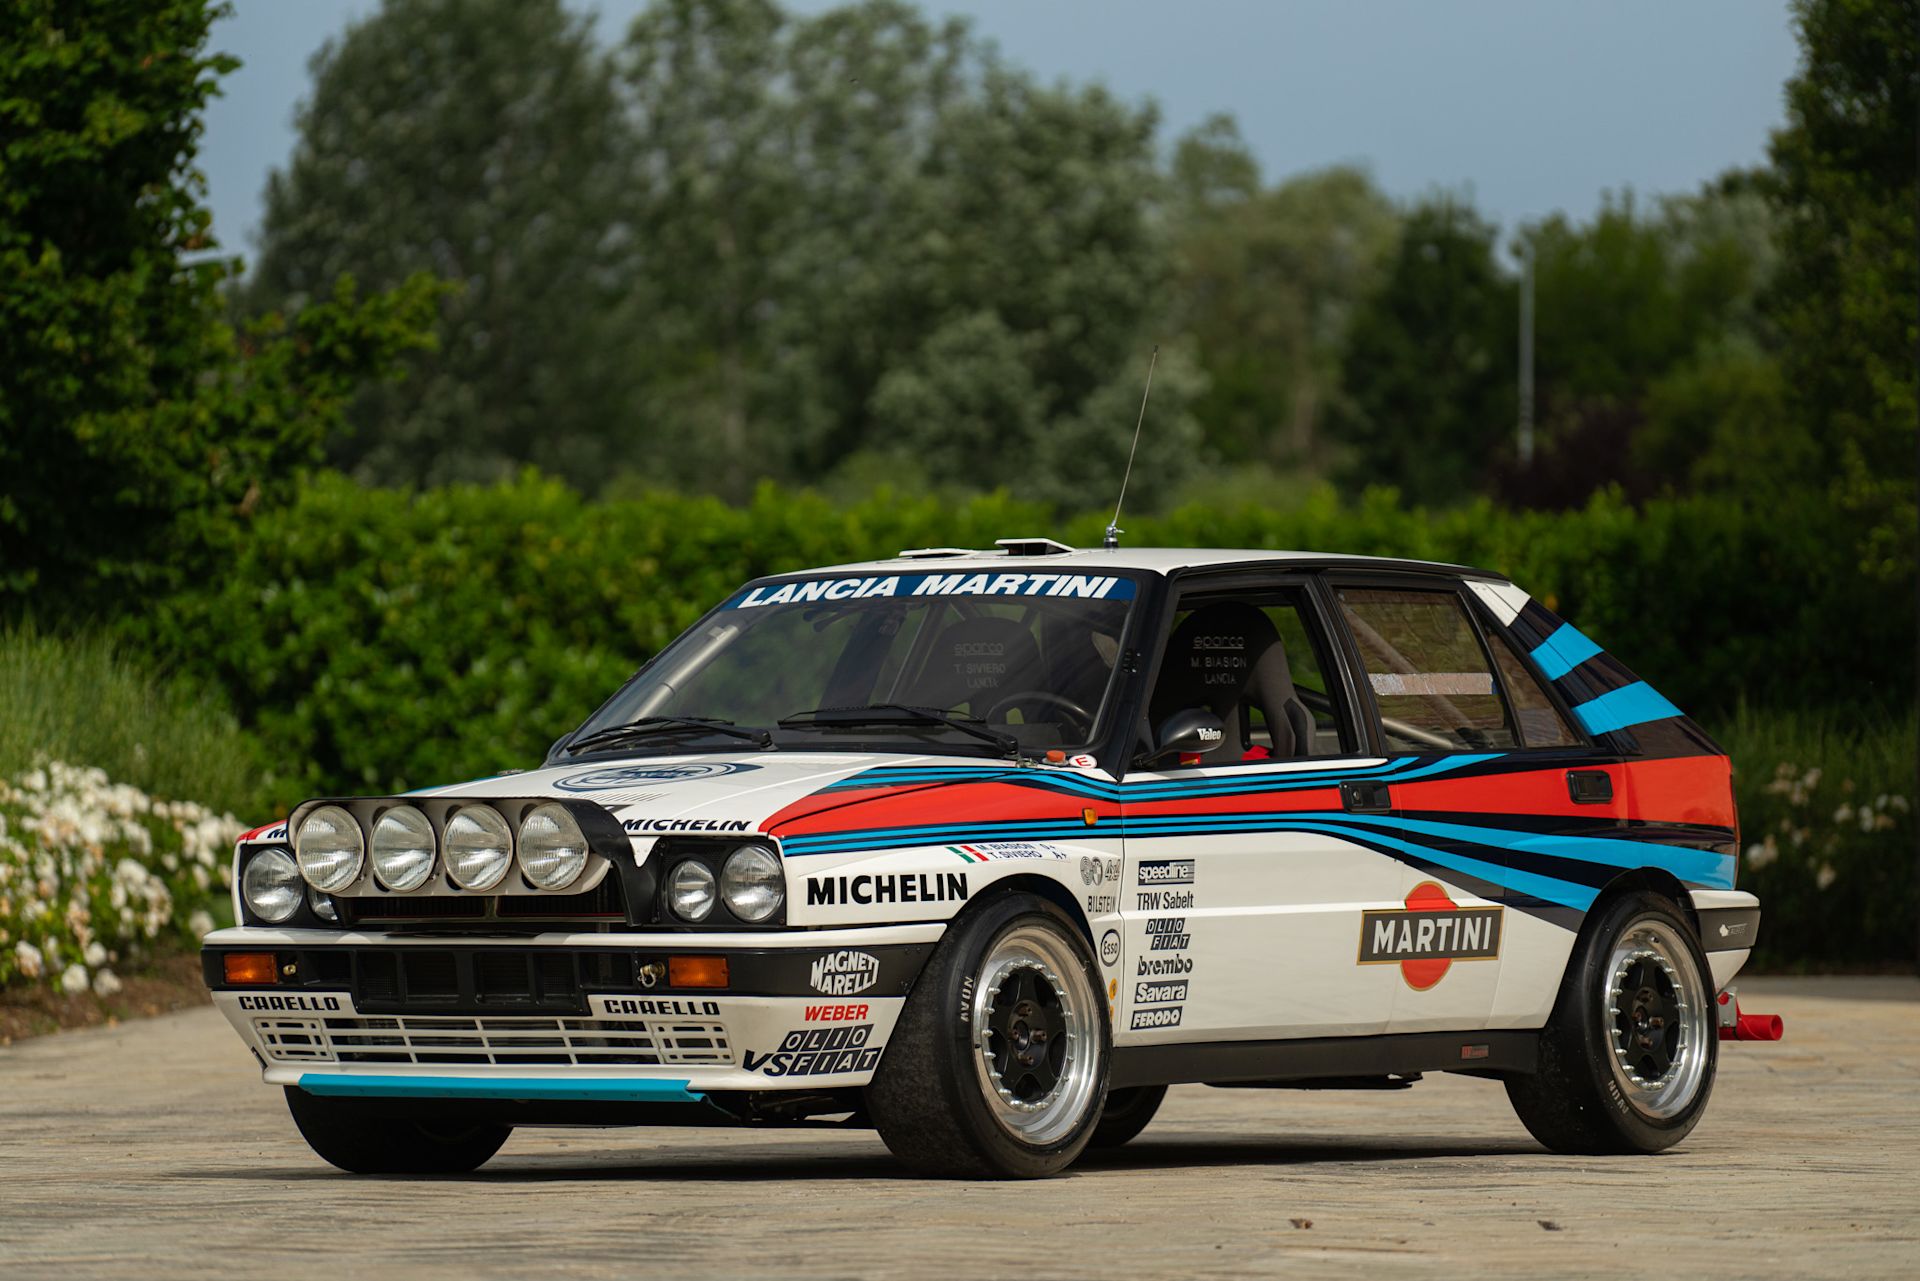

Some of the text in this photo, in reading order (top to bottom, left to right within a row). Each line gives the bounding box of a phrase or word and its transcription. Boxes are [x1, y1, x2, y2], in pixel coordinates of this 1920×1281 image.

[737, 573, 1118, 608] LANCIA MARTINI
[966, 663, 1006, 674] SIVIERO
[1205, 656, 1247, 668] BIASION
[1197, 728, 1222, 740] Valeo
[1075, 757, 1091, 767] E
[623, 819, 752, 831] MICHELIN
[1140, 862, 1188, 883] speedline
[807, 873, 968, 905] MICHELIN
[1088, 895, 1117, 912] BILSTEIN
[1137, 891, 1194, 910] TRW Sabelt
[1146, 919, 1184, 933] OLIO
[1152, 935, 1190, 949] FIAT
[1372, 917, 1492, 954] MARTINI
[1103, 941, 1118, 955] Esso
[1137, 953, 1193, 976] brembo
[960, 976, 975, 1023] AVON
[1136, 983, 1186, 1002] Savara
[238, 996, 340, 1010] CARELLO
[603, 1000, 720, 1015] CARELLO
[805, 1004, 869, 1021] WEBER
[1133, 1009, 1180, 1028] FERODO
[781, 1026, 870, 1050] OLIO
[789, 1048, 880, 1076] FIAT
